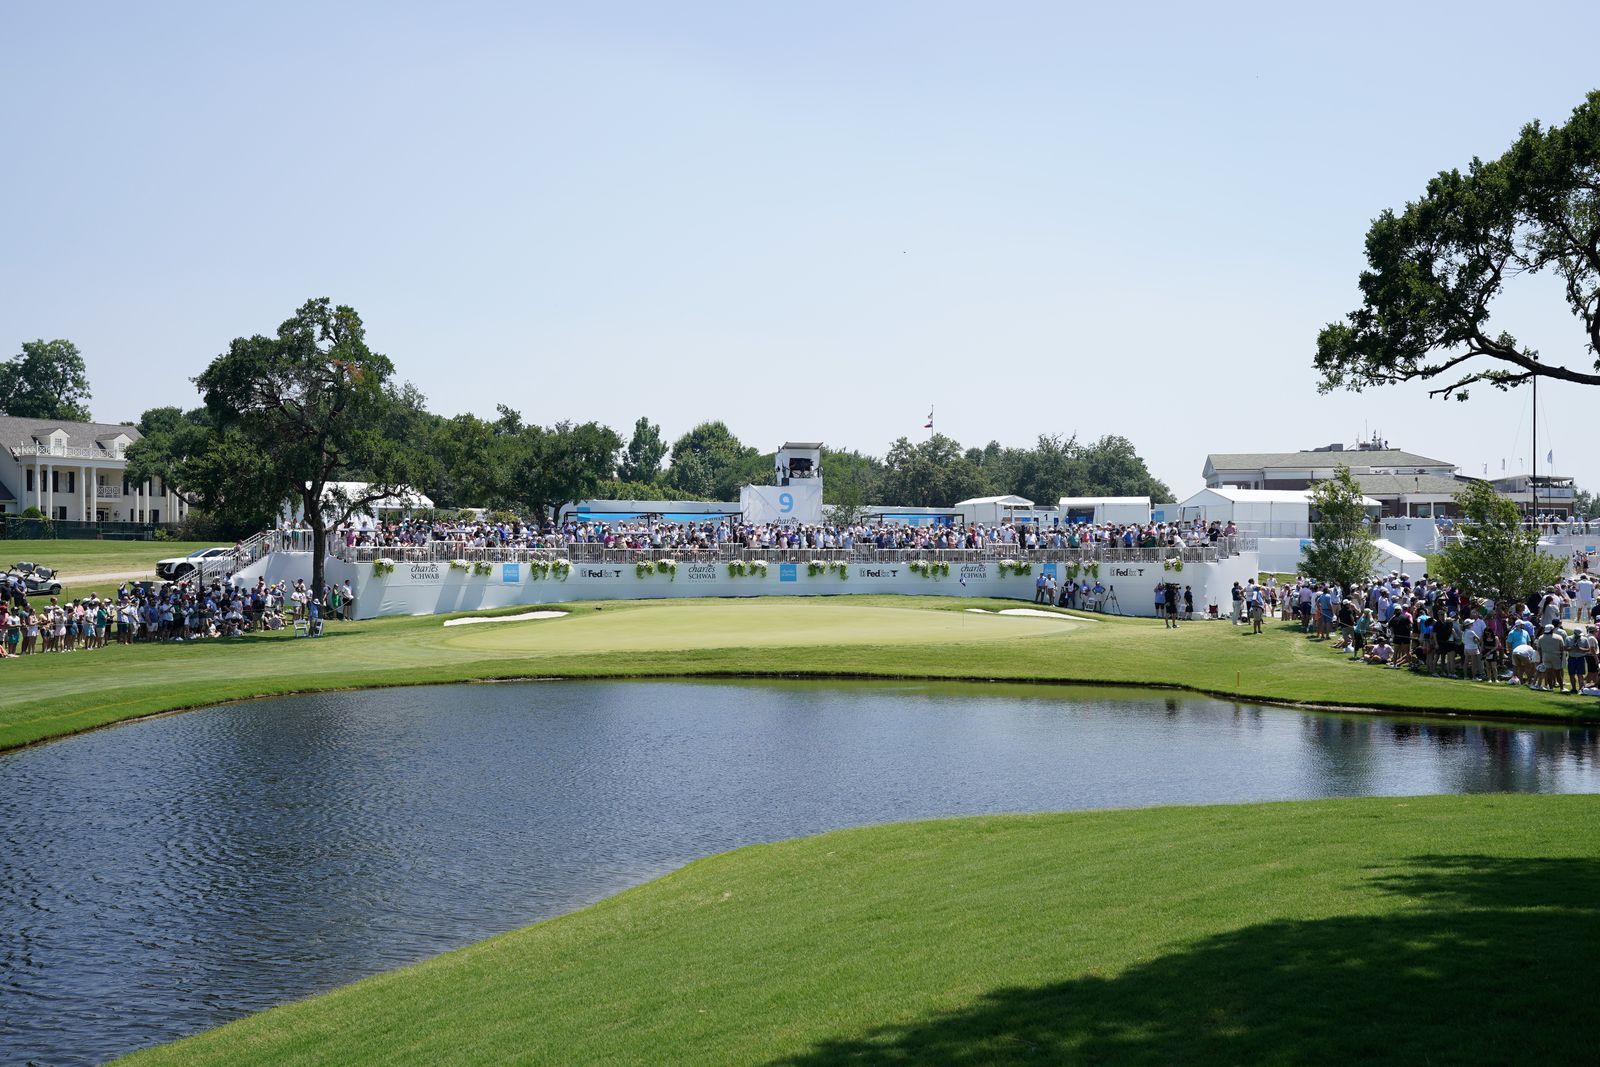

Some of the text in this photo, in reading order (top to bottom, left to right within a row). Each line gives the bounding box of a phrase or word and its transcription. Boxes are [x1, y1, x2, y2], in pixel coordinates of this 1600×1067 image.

[779, 493, 794, 514] 9
[410, 564, 439, 573] charles
[688, 564, 716, 573] charles
[960, 564, 986, 573] charles
